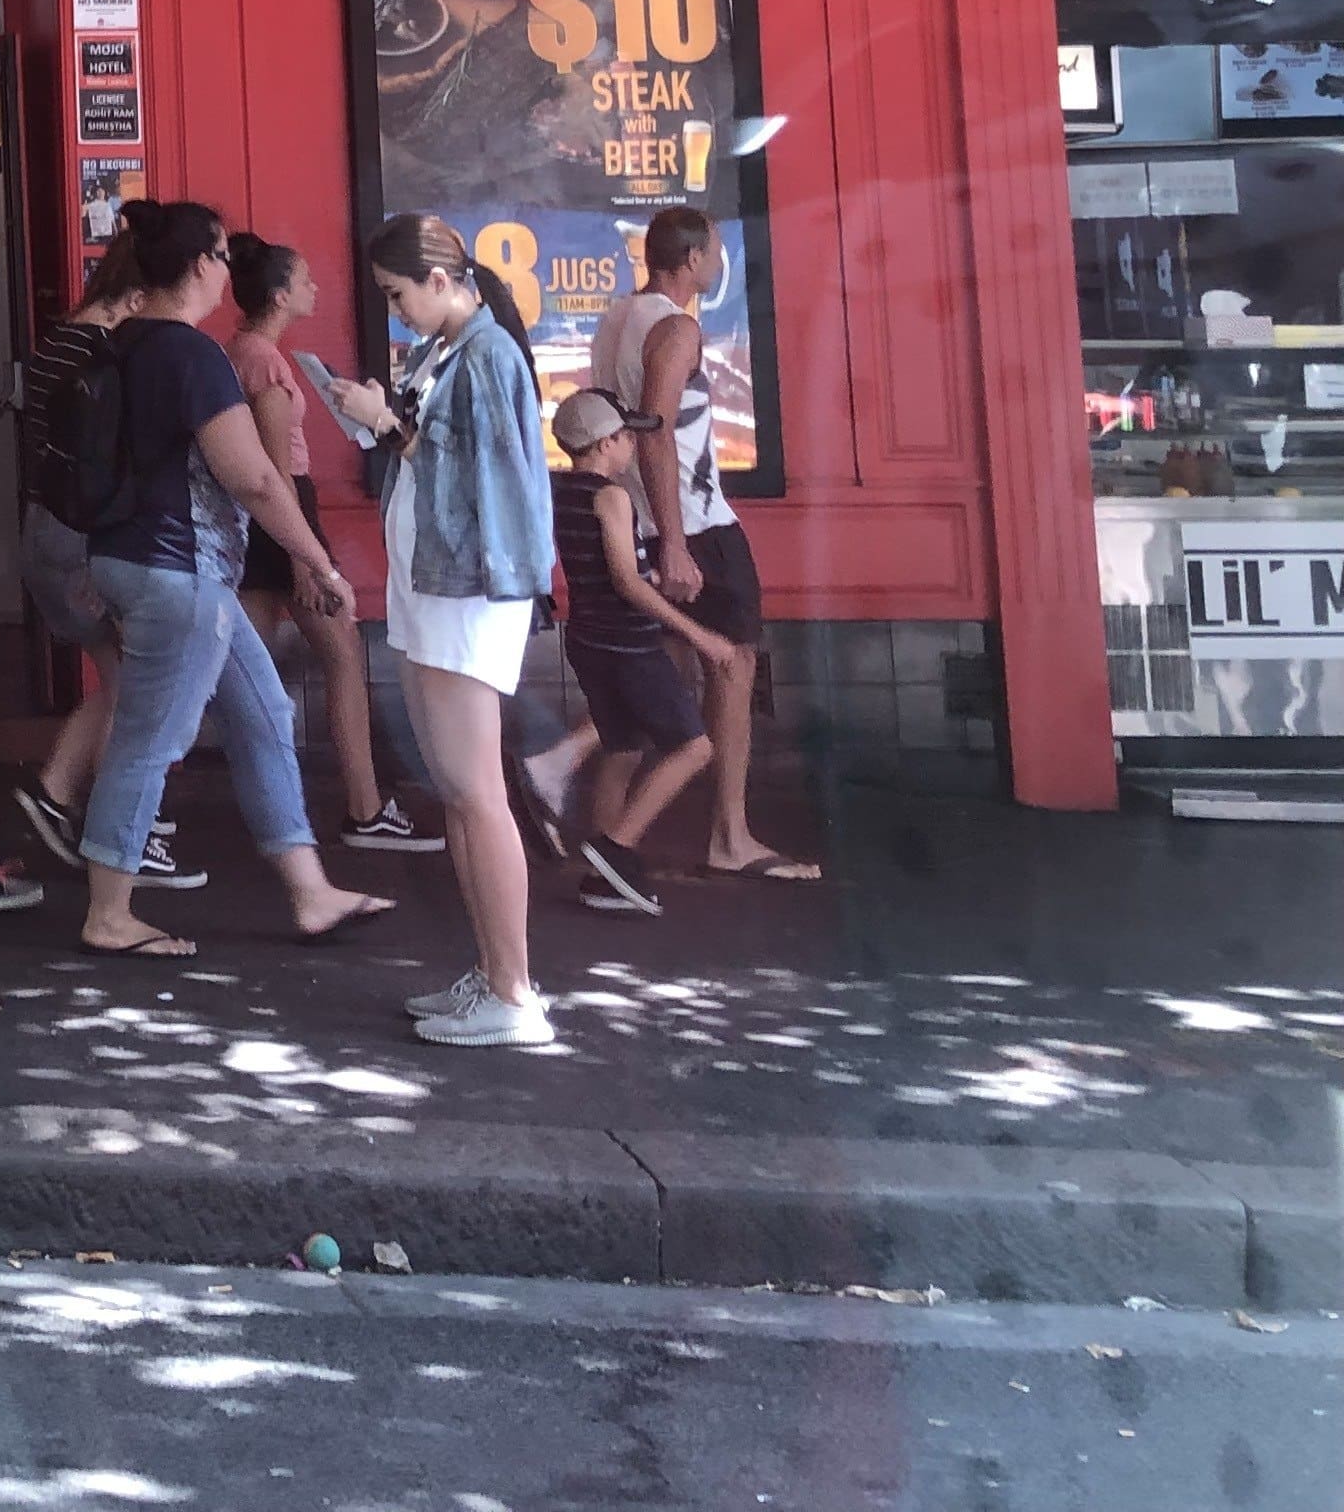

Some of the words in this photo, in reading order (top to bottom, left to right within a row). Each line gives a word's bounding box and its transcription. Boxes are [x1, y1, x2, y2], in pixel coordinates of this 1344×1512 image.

[90, 44, 124, 55] MOJO
[89, 61, 126, 73] HOTEL
[592, 70, 694, 112] STEAK
[84, 108, 111, 117] ROHIT
[113, 108, 134, 117] RAM
[87, 121, 132, 131] SHRESTHA
[624, 114, 656, 133] with
[82, 159, 97, 169] NO
[452, 221, 541, 330] 8
